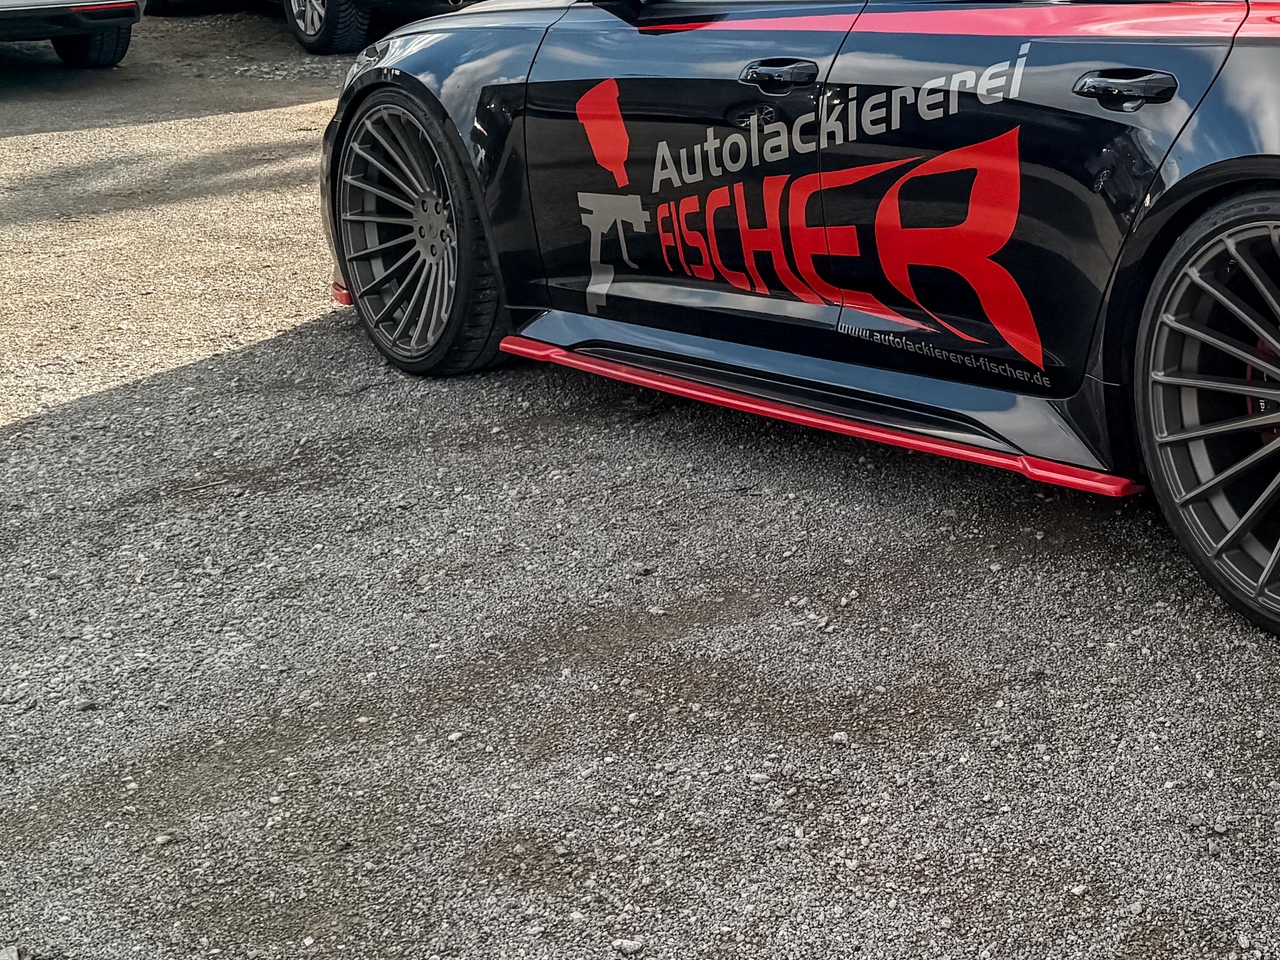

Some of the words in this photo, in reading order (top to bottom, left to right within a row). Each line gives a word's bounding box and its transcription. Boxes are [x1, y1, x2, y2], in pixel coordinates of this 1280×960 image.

[652, 42, 1031, 193] Autolackiererei
[657, 125, 1044, 370] FISCHER
[837, 322, 1051, 388] www.autolackiererei-fischer.de
